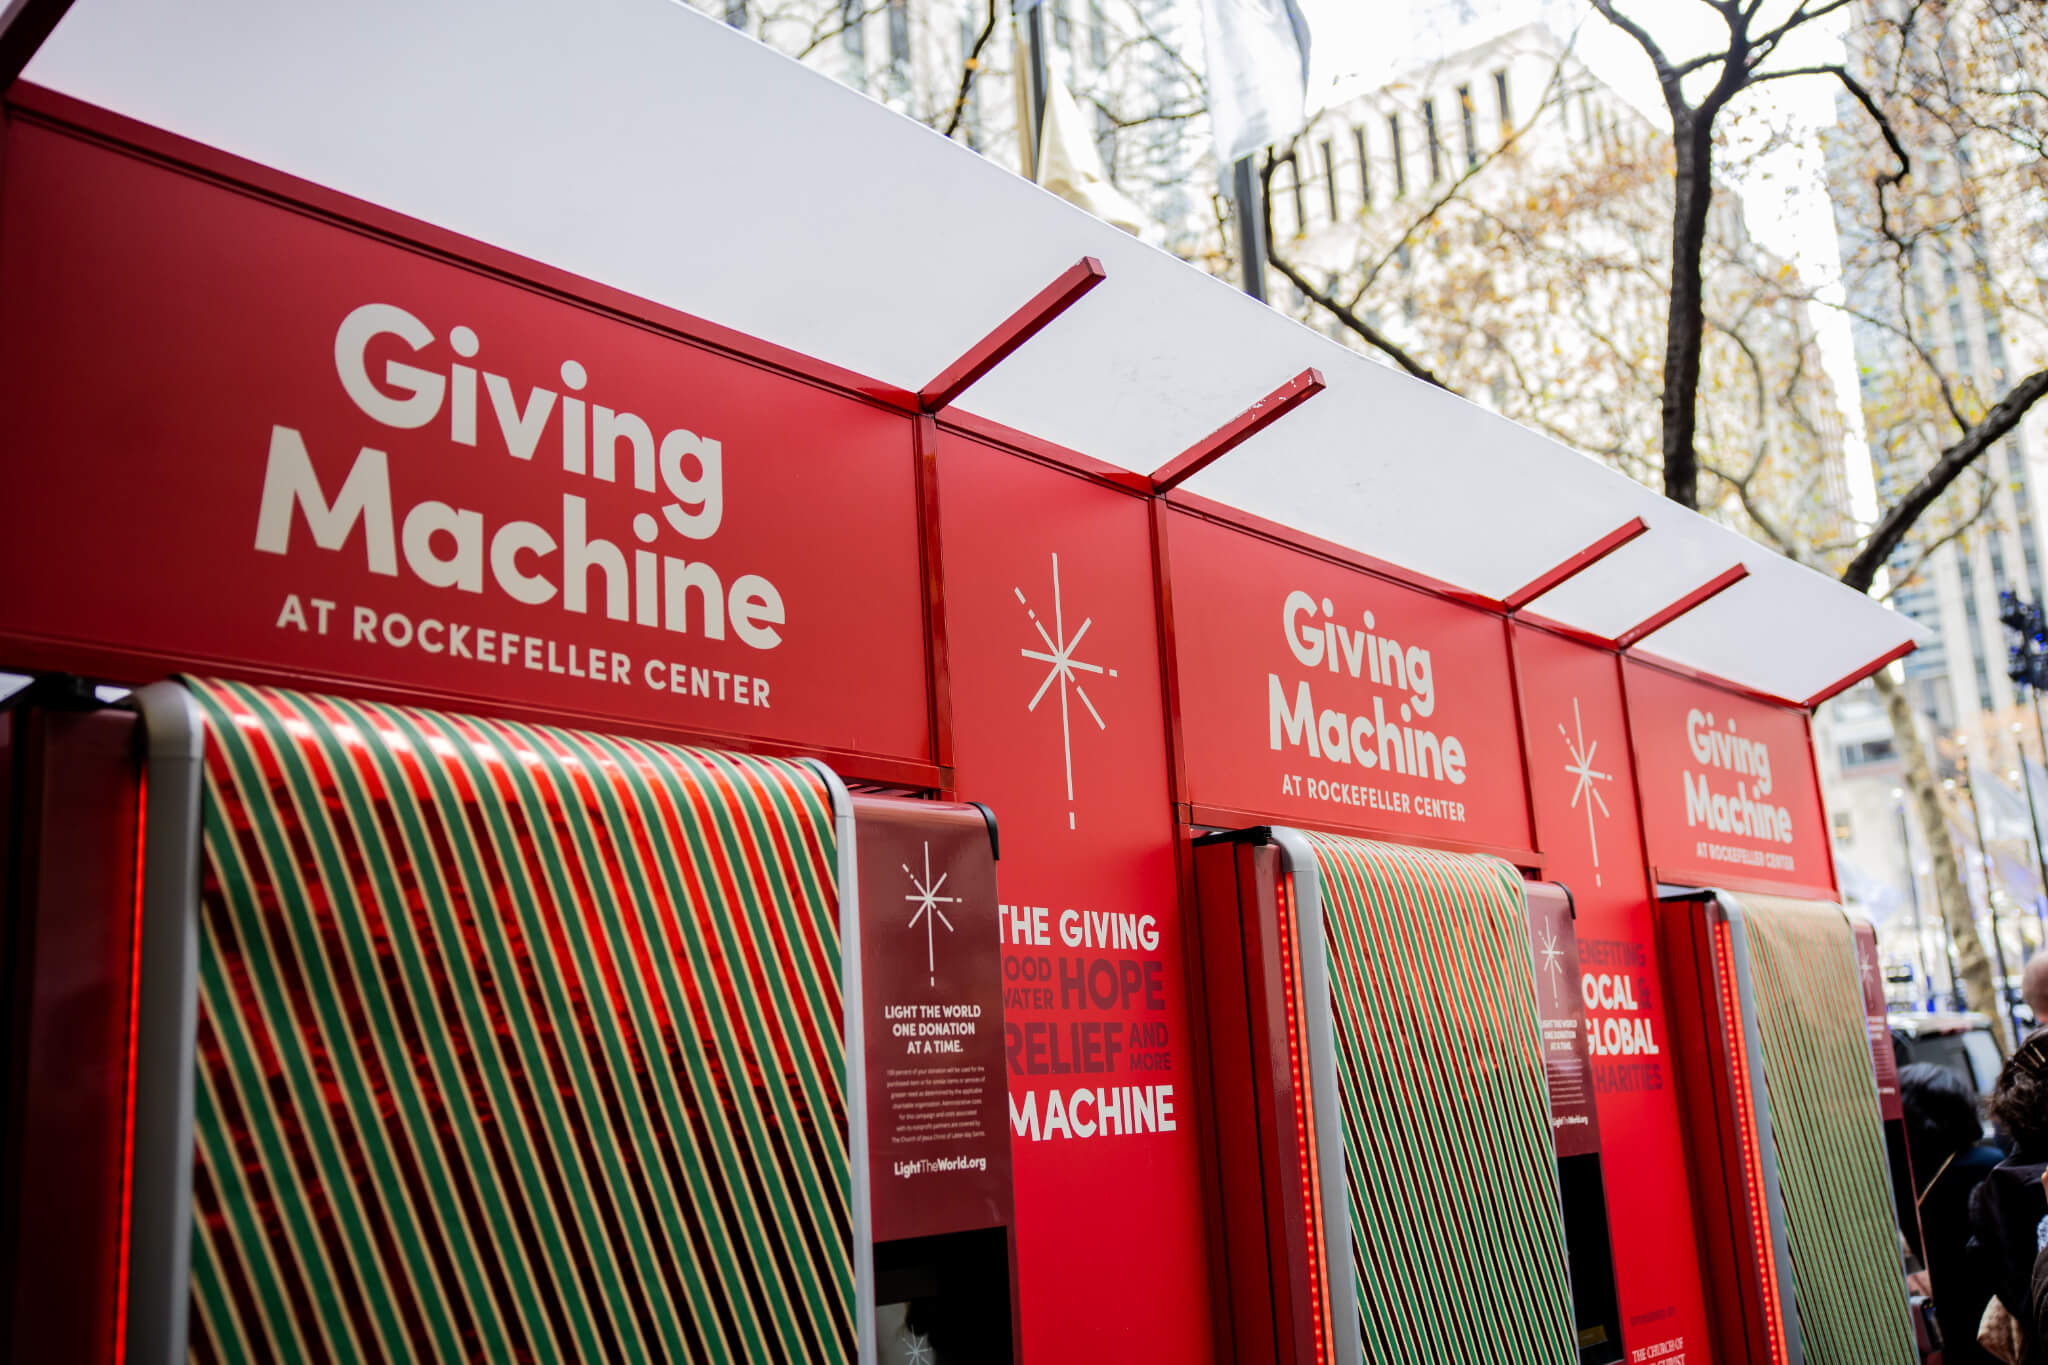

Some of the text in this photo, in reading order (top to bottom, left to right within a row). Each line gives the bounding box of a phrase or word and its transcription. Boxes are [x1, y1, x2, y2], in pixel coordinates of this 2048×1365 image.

[334, 303, 723, 539] Giving
[254, 424, 785, 649] Machine
[276, 594, 771, 708] AT ROCKEFELLER CENTER
[1283, 590, 1435, 717] Giving
[1268, 672, 1467, 785] Machine
[1686, 708, 1772, 796] Giving
[1282, 774, 1466, 822] AT ROCKEFELLER CENTER
[1683, 769, 1793, 844] Machine
[998, 904, 1160, 951] THE GIVING
[1003, 956, 1052, 981] OOD
[1058, 957, 1166, 1011] HOPE
[1582, 973, 1638, 1010] OCAL
[885, 1005, 981, 1018] LIGHT THE WORLD
[892, 1022, 975, 1036] ONE DONATION
[1129, 1022, 1169, 1049] AND
[907, 1040, 963, 1054] AT A TIME.
[1005, 1022, 1123, 1075] RELIEF
[1130, 1052, 1171, 1073] MORE
[1594, 1064, 1663, 1094] HARITIES
[1008, 1084, 1177, 1141] MACHINE
[894, 1155, 987, 1178] LightTheWorld.org
